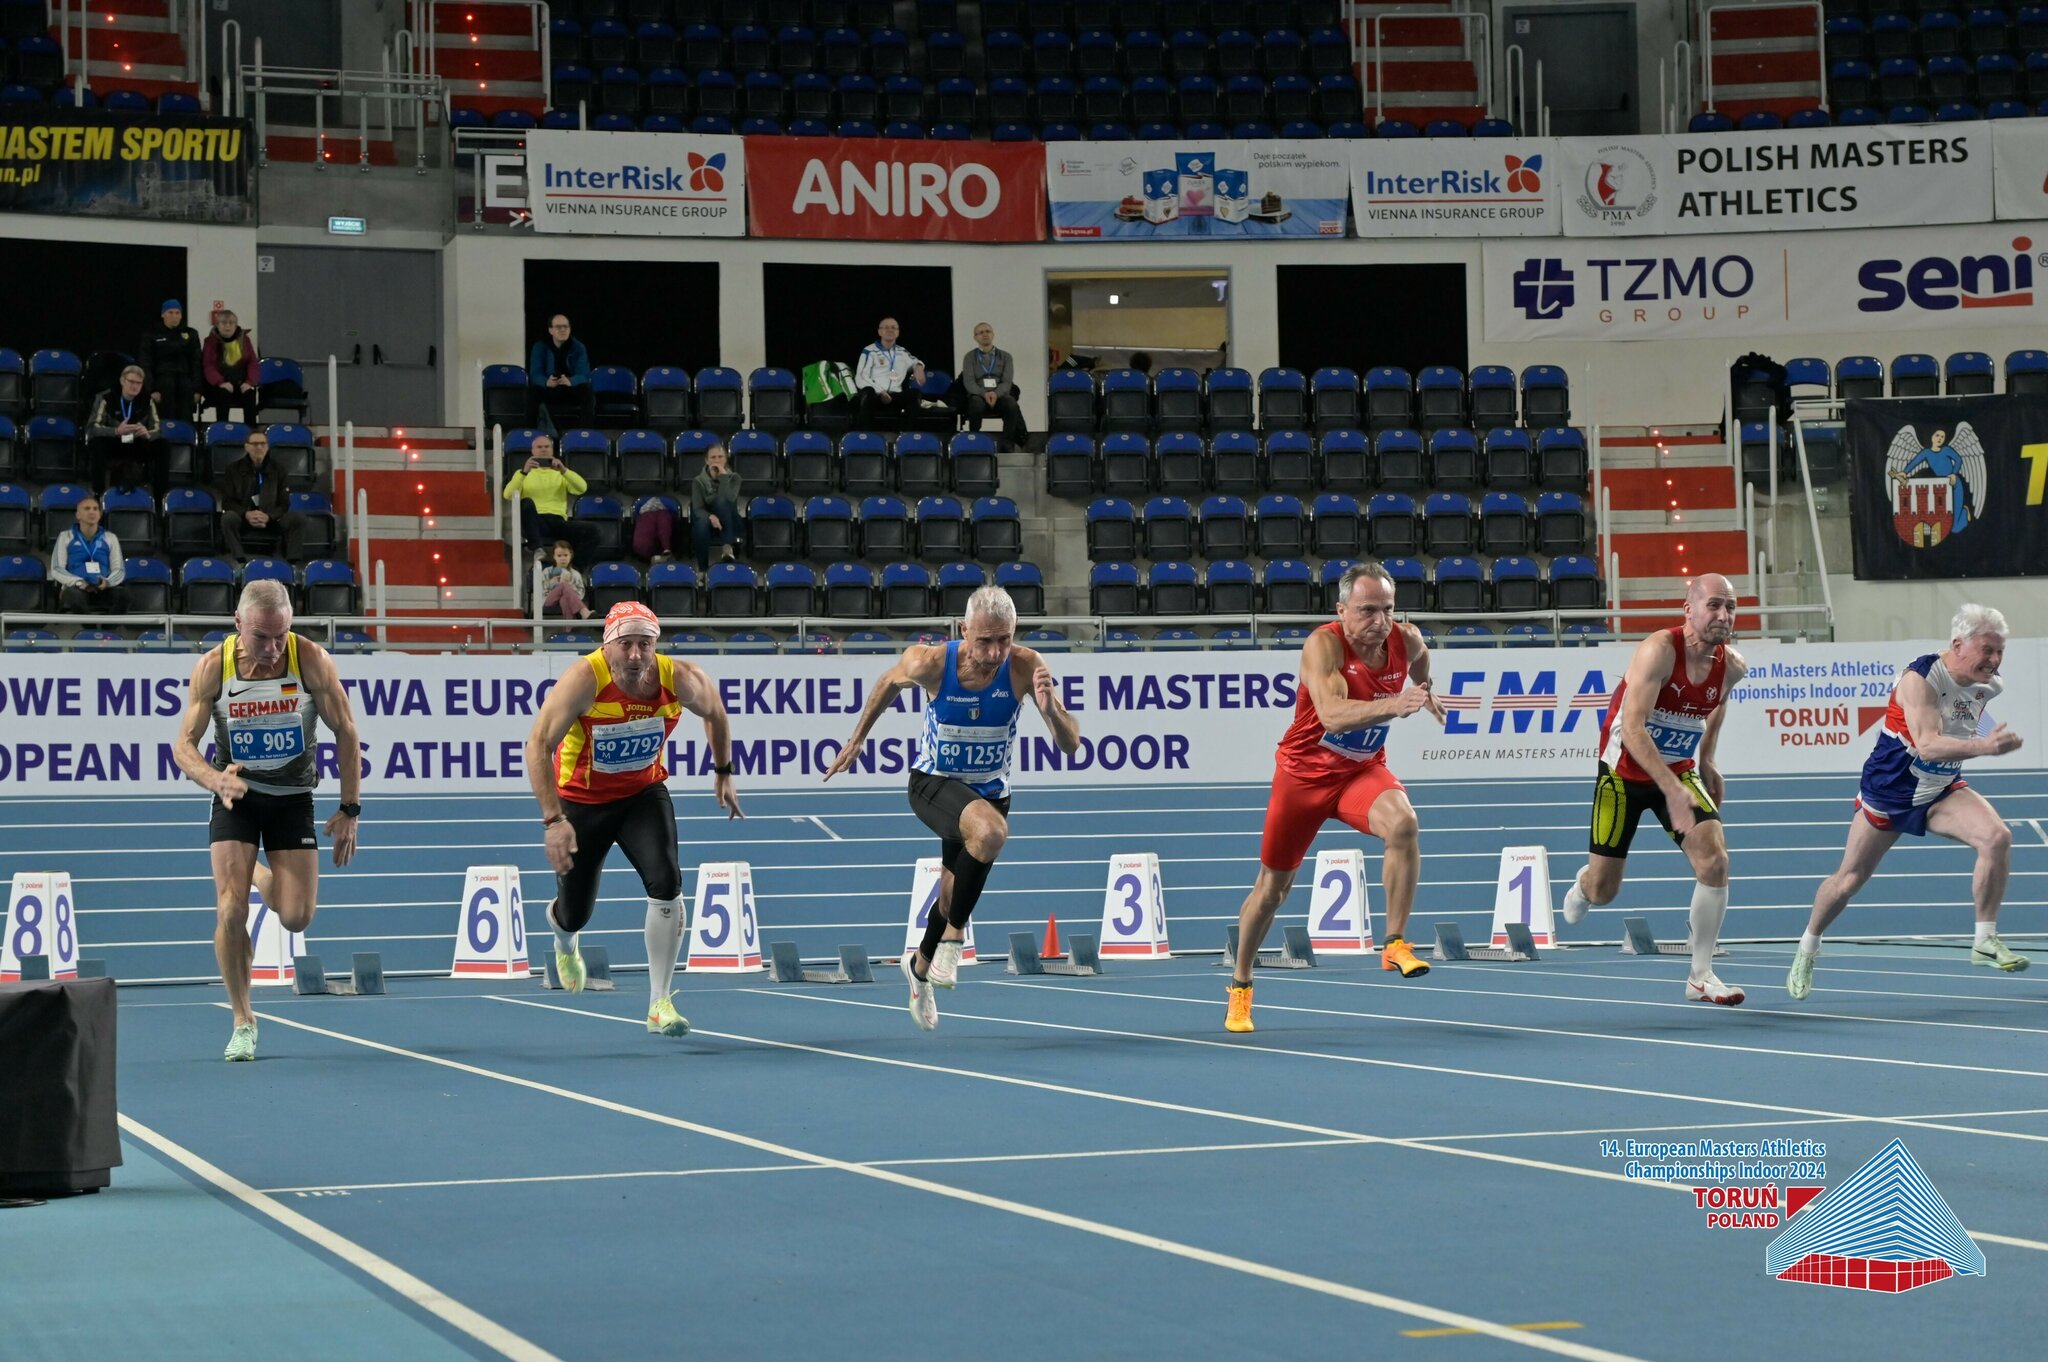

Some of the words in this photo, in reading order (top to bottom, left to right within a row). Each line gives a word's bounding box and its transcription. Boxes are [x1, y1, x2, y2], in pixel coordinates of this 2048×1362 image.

[120, 127, 241, 162] SPORTU
[1678, 145, 1799, 174] POLISH
[1810, 137, 1969, 169] MASTERS
[545, 163, 684, 191] InterRisk
[1258, 160, 1292, 169] polskim
[1367, 170, 1501, 194] InterRisk
[792, 158, 1001, 219] ANIRO
[1678, 186, 1858, 217] ATHLETICS
[546, 203, 597, 214] VIENNA
[601, 205, 677, 217] INSURANCE
[682, 207, 727, 218] GROUP
[1368, 208, 1417, 220] VIENNA
[1421, 207, 1496, 219] INSURANCE
[1500, 207, 1544, 219] GROUP
[1602, 211, 1632, 220] PMA
[1586, 254, 1754, 301] TZMO
[1857, 236, 2034, 312] seni
[1599, 305, 1750, 323] GROUP
[1771, 663, 1828, 678] Masters
[1831, 661, 1895, 676] Athletics
[97, 678, 190, 716] MIS
[719, 678, 863, 715] EKKIEJ
[1098, 672, 1297, 710] MASTERS
[1444, 670, 1609, 735] EMA
[1810, 682, 1857, 698] Indoor
[1860, 682, 1894, 698] 2024
[229, 698, 298, 718] GERMANY
[1765, 703, 1849, 728] TORUŃ
[233, 732, 254, 745] 60
[262, 731, 295, 752] 905
[596, 741, 617, 752] 60
[620, 735, 661, 757] 2792
[940, 743, 961, 757] 60
[965, 744, 1005, 765] 1255
[1020, 734, 1190, 771] INDOOR
[1362, 728, 1382, 747] 17
[1422, 750, 1491, 760] EUROPEAN
[1495, 749, 1556, 759] MASTERS
[1561, 747, 1599, 758] ATHLE
[1663, 731, 1696, 750] 234
[1781, 732, 1850, 746] POLAND
[384, 741, 528, 779] ATHLE
[945, 757, 955, 766] M
[1112, 873, 1143, 936] 3
[1152, 873, 1163, 935] 3
[1318, 869, 1352, 931] 2
[1509, 866, 1532, 927] 1
[13, 895, 43, 962] 8
[56, 894, 73, 963] 8
[467, 887, 499, 953] 6
[511, 886, 522, 952] 6
[700, 883, 730, 948] 5
[741, 882, 754, 947] 5
